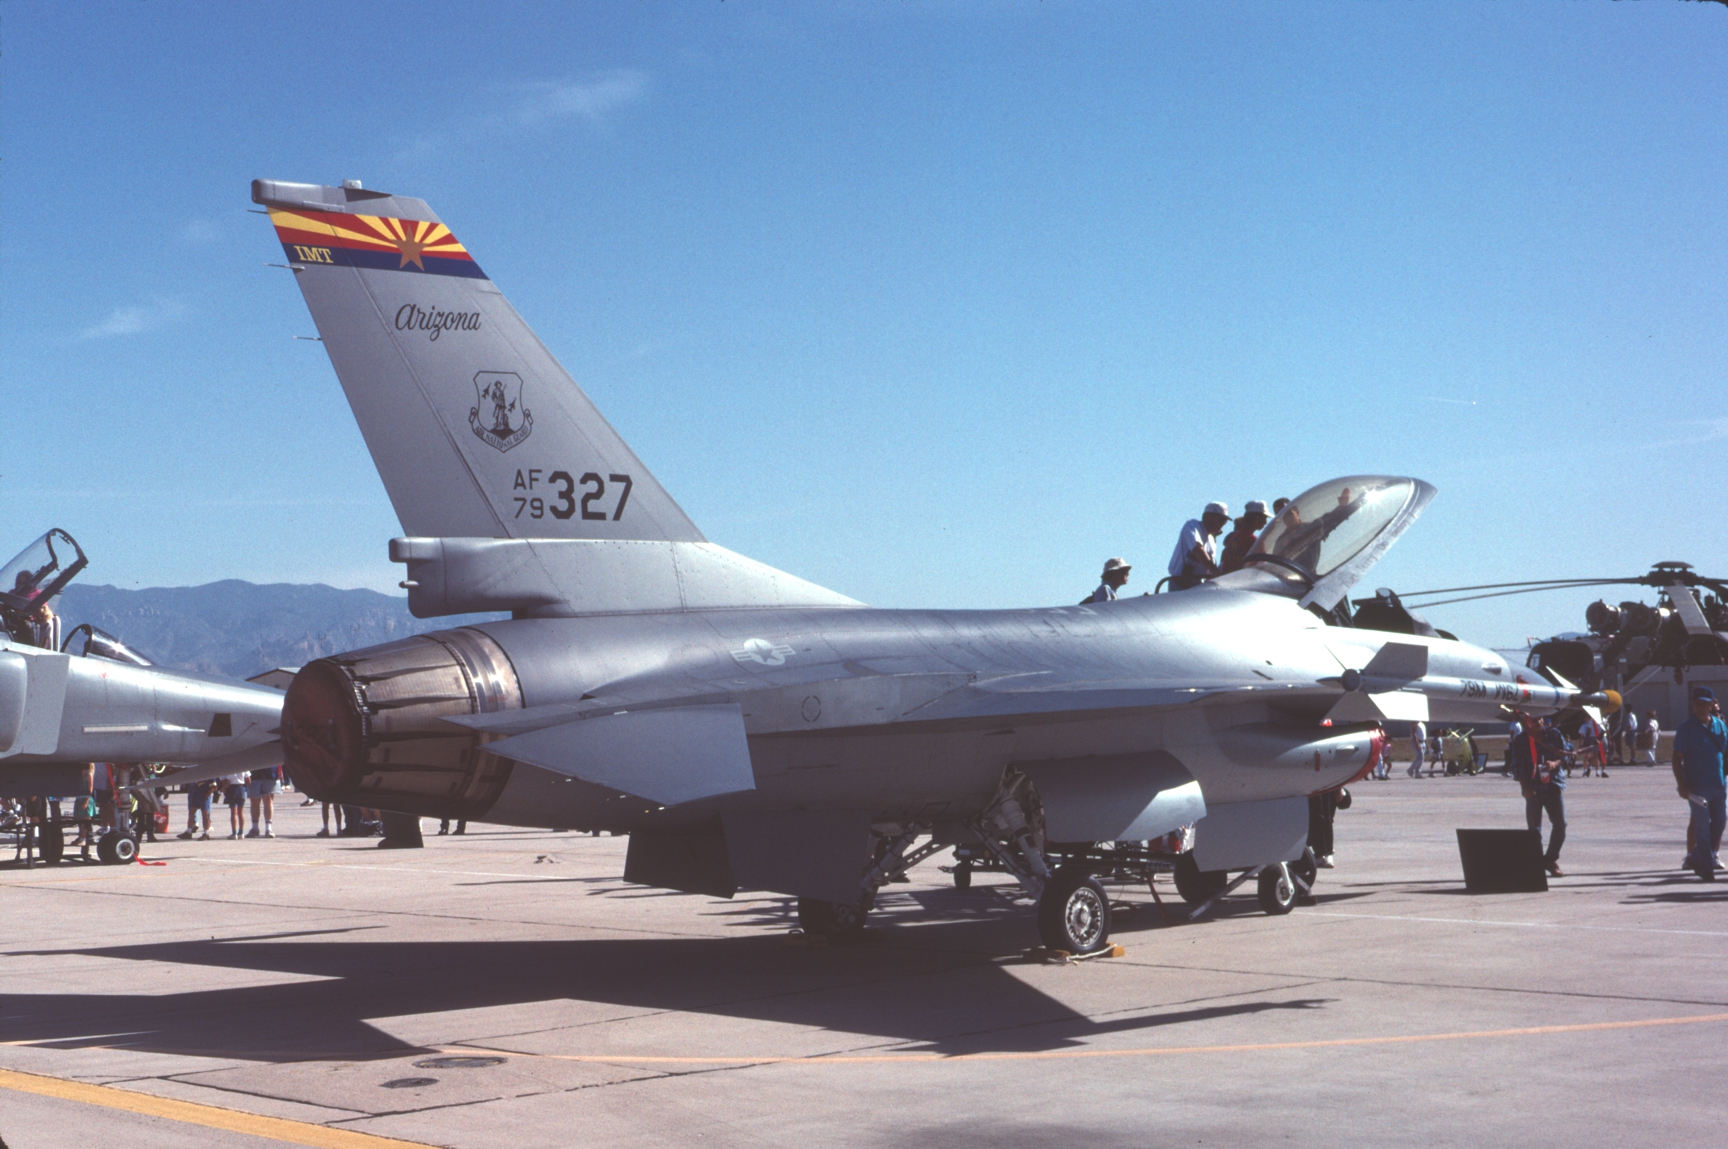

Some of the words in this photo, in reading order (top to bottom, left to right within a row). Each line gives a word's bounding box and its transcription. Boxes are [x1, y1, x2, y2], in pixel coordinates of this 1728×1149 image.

[293, 245, 334, 263] IMT
[395, 303, 481, 341] Arizona
[513, 469, 542, 490] AF
[548, 470, 633, 521] 327
[513, 497, 544, 519] 79
